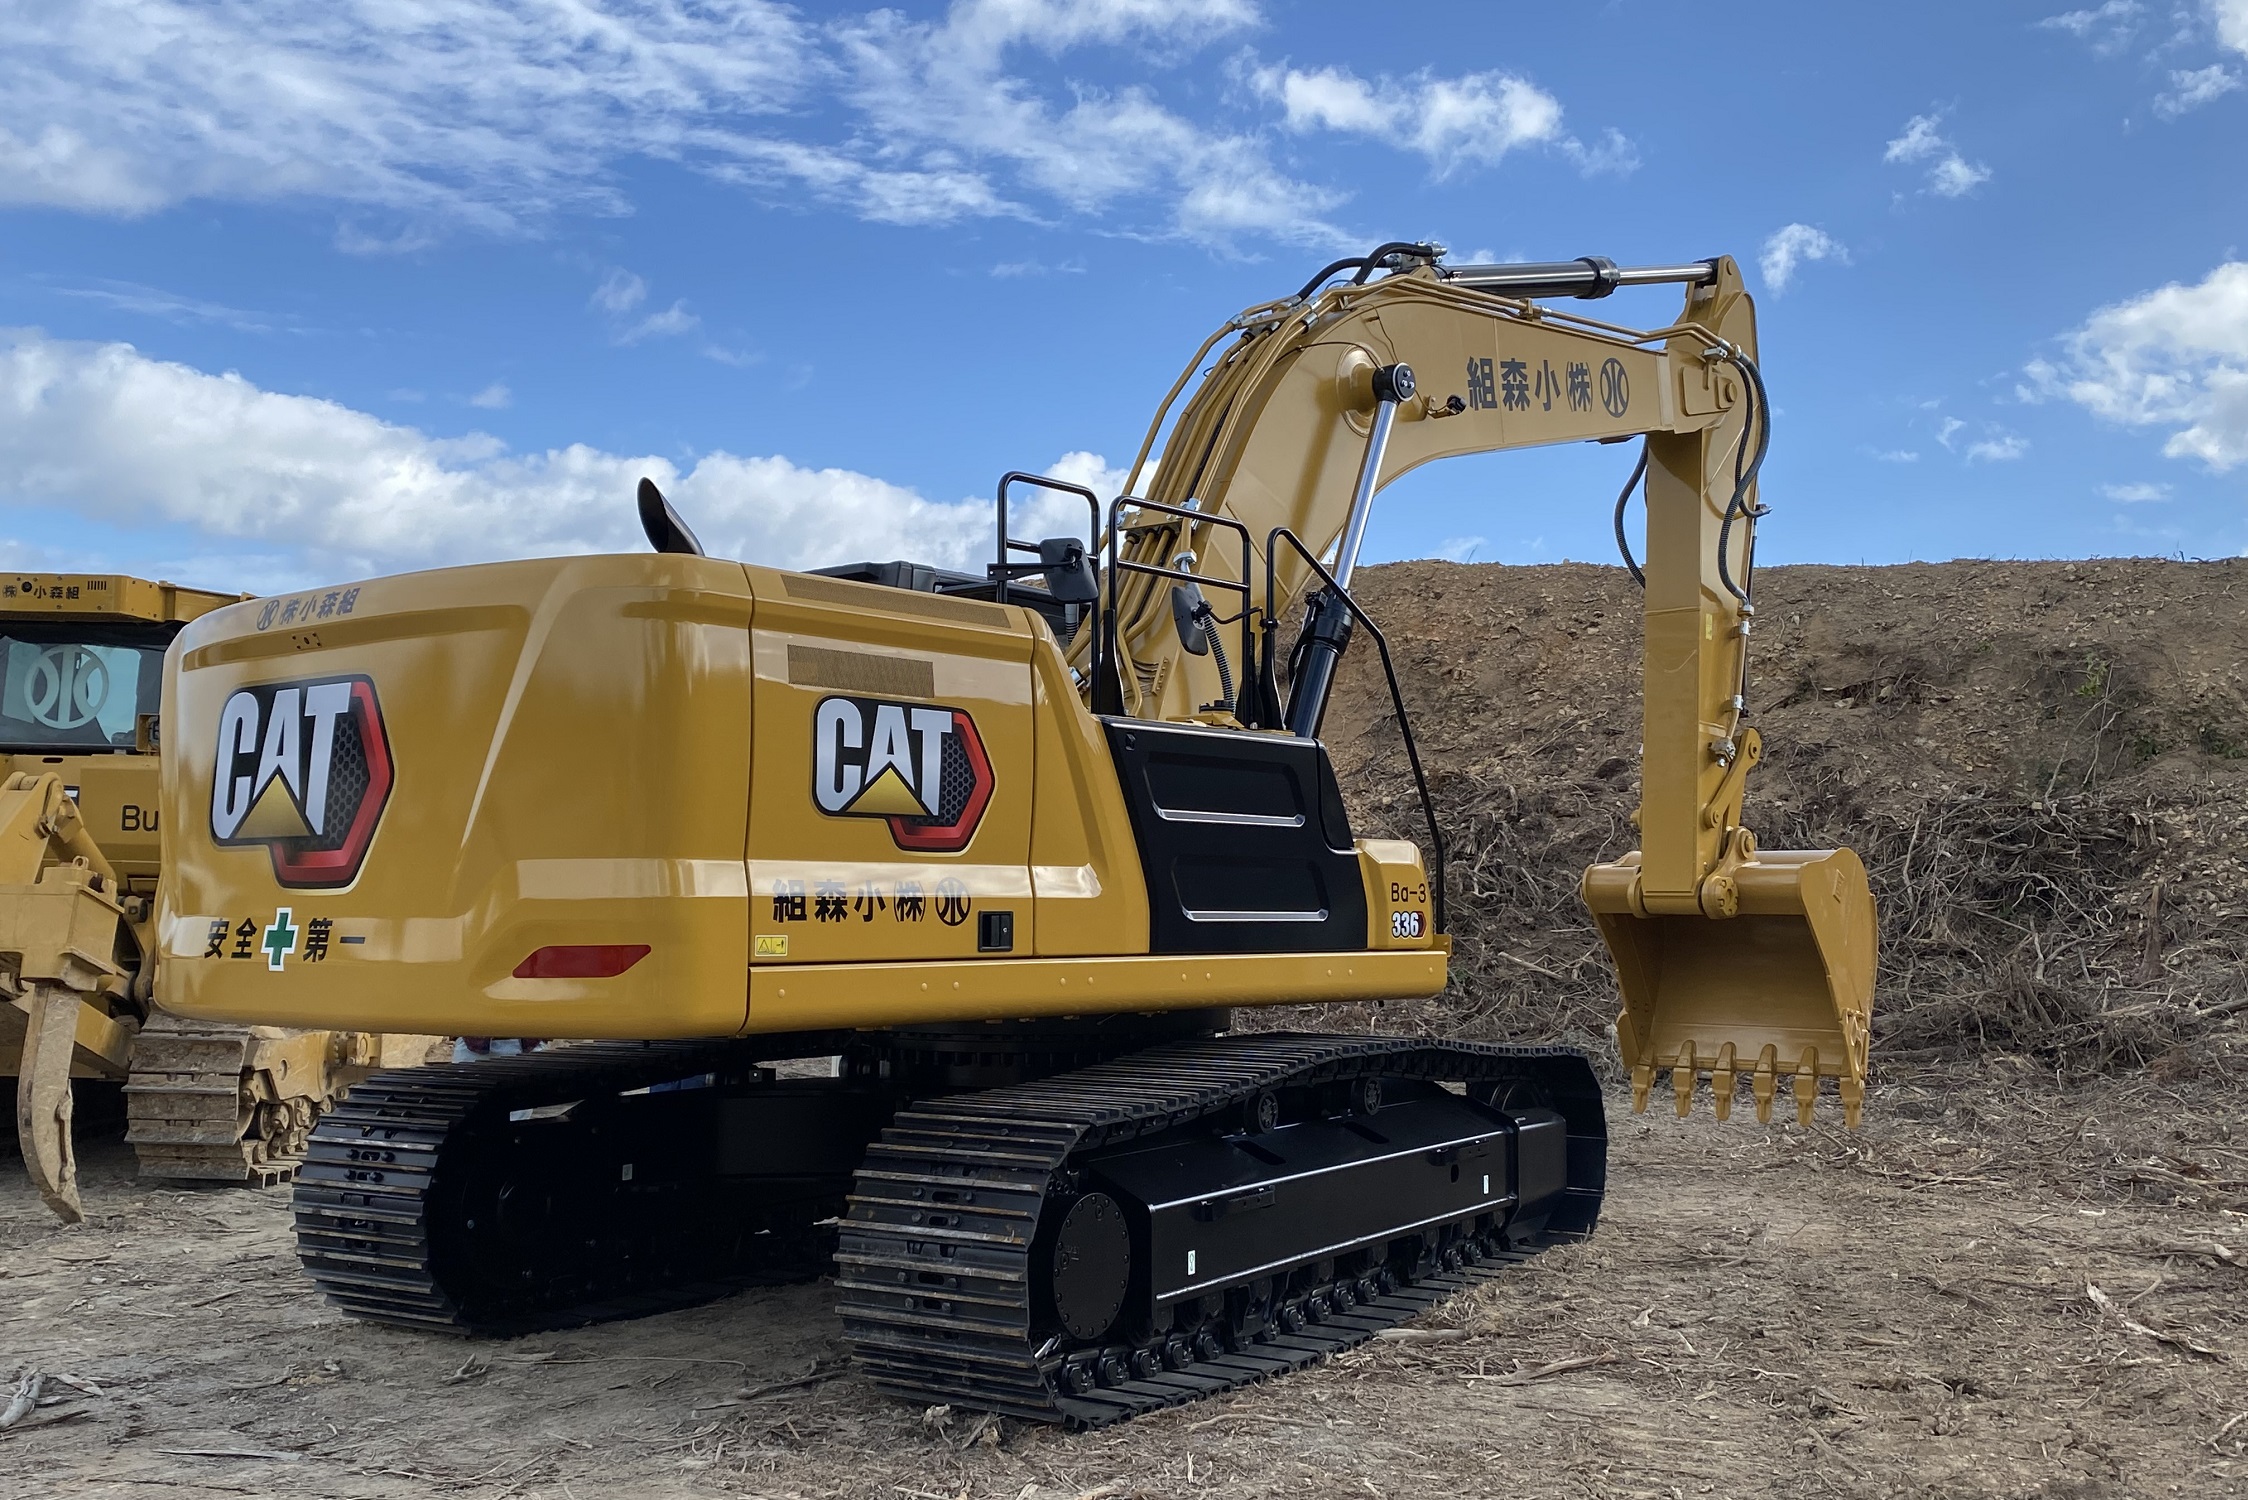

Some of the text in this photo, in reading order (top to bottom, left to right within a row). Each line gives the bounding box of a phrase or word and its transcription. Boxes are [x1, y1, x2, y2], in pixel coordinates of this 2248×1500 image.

[211, 682, 352, 839] CAT
[815, 698, 952, 816] CAT
[1391, 882, 1427, 903] Ba-3
[1391, 911, 1420, 938] 336
